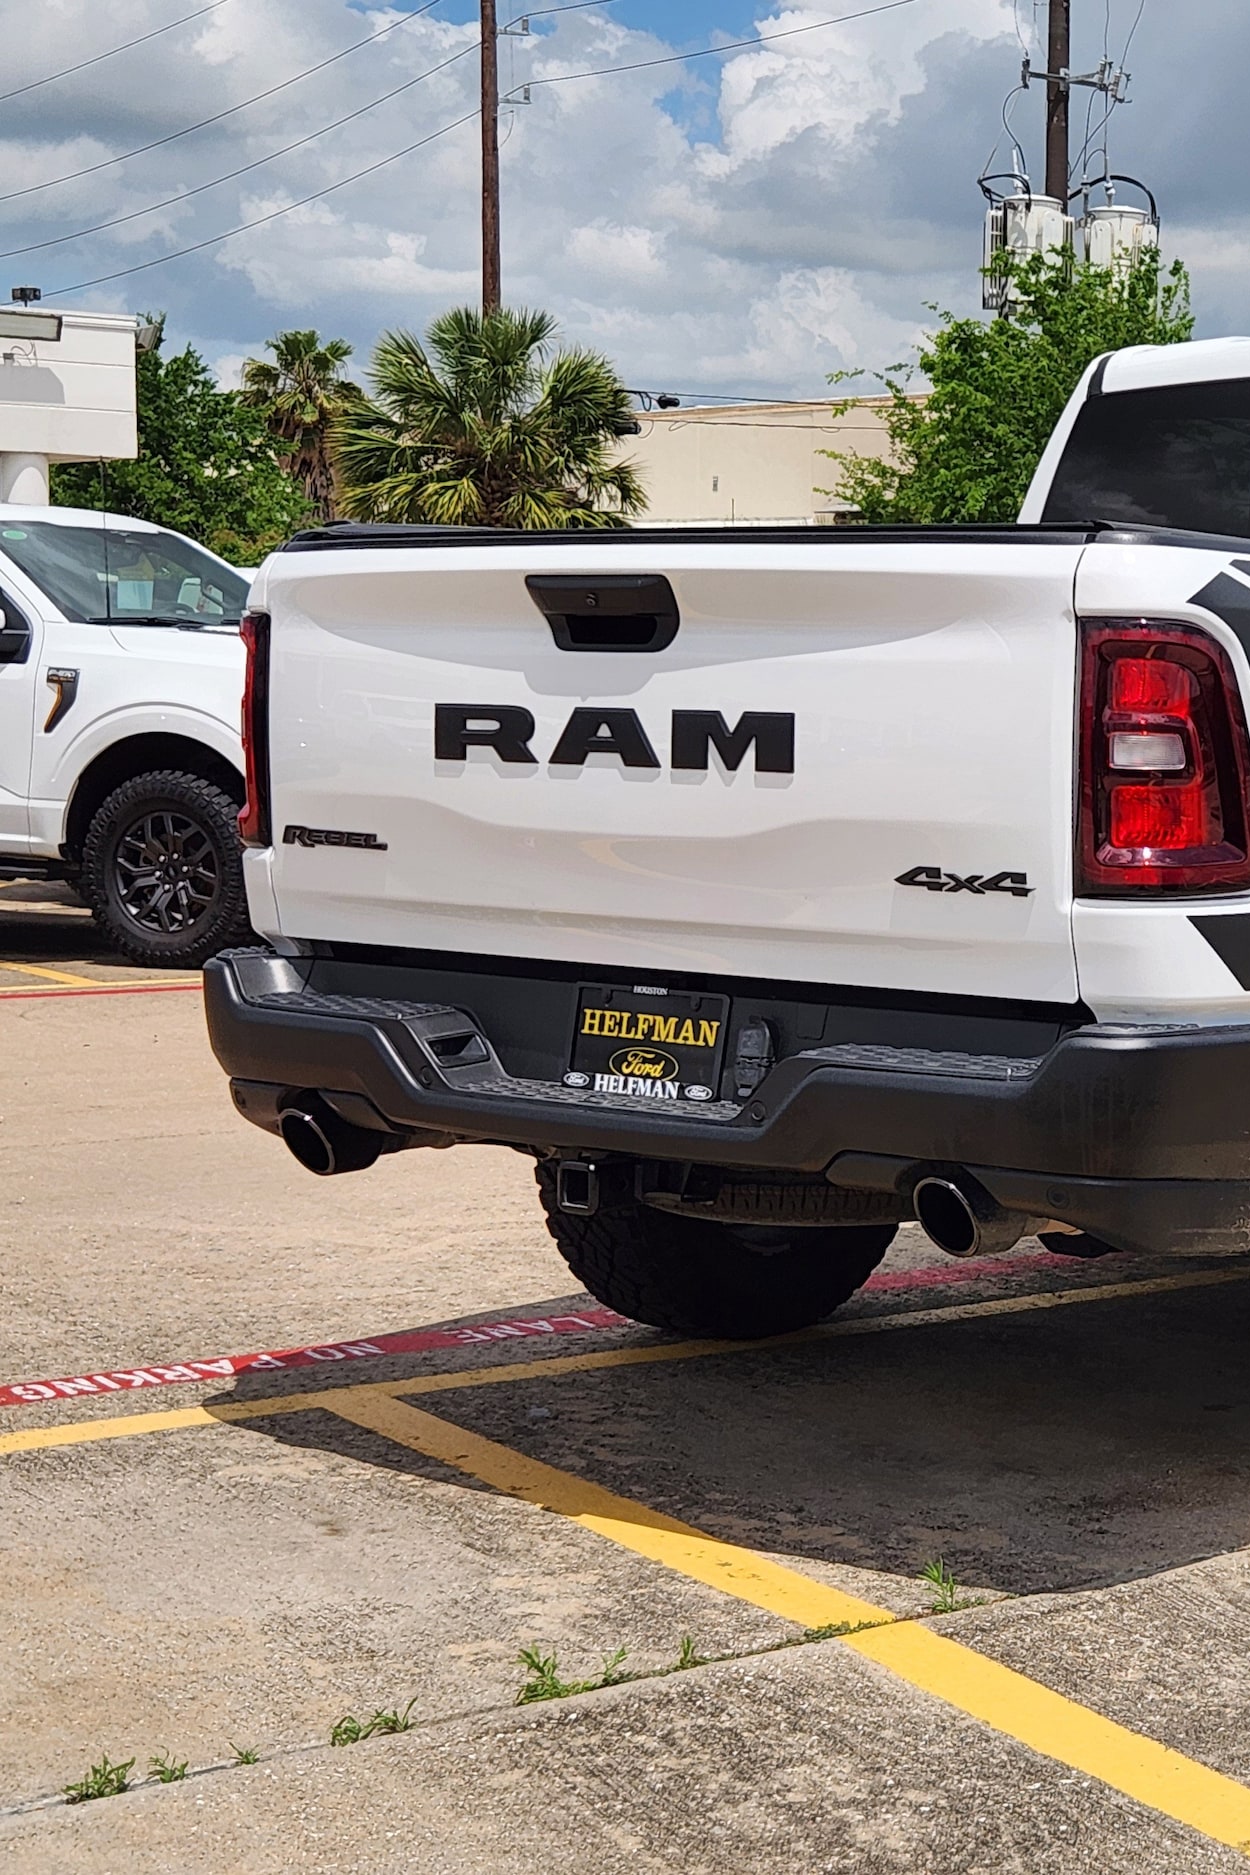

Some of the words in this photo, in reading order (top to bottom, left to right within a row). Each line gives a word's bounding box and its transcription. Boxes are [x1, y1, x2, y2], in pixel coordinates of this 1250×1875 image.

[434, 702, 796, 774] RAM
[282, 825, 389, 851] REBEL
[633, 985, 668, 995] HOUSTON
[581, 1008, 721, 1048] HELFMAN
[621, 1051, 666, 1078] Ford
[593, 1073, 681, 1100] HELFMAN
[304, 1341, 387, 1361] NO
[10, 1353, 287, 1400] PARKING
